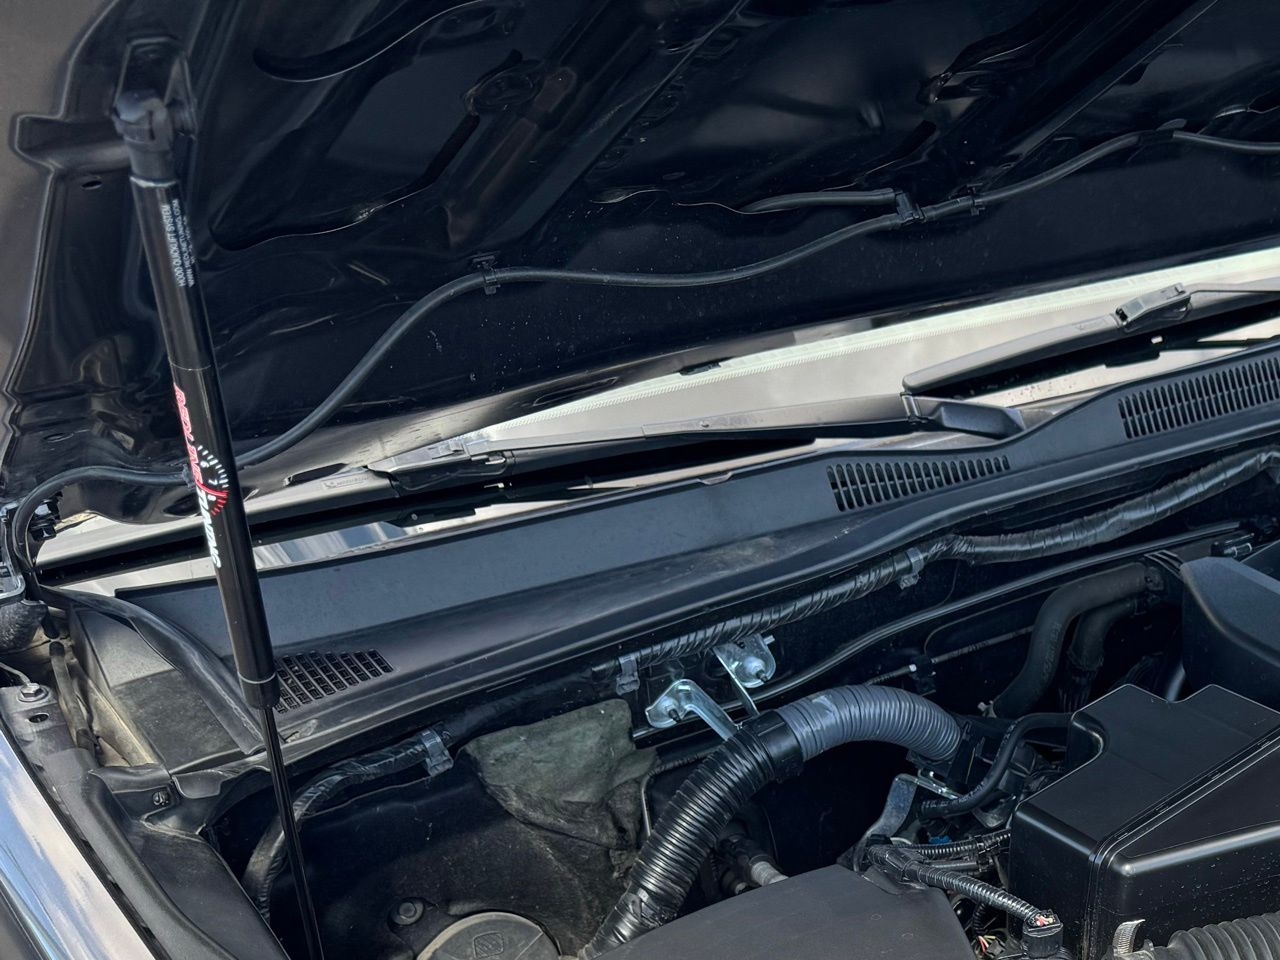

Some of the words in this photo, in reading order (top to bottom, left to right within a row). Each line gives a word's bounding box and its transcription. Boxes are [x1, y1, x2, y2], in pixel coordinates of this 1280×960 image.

[161, 204, 176, 232] SYSTEM
[174, 266, 187, 287] HOOD
[173, 382, 204, 484] REDLINE
